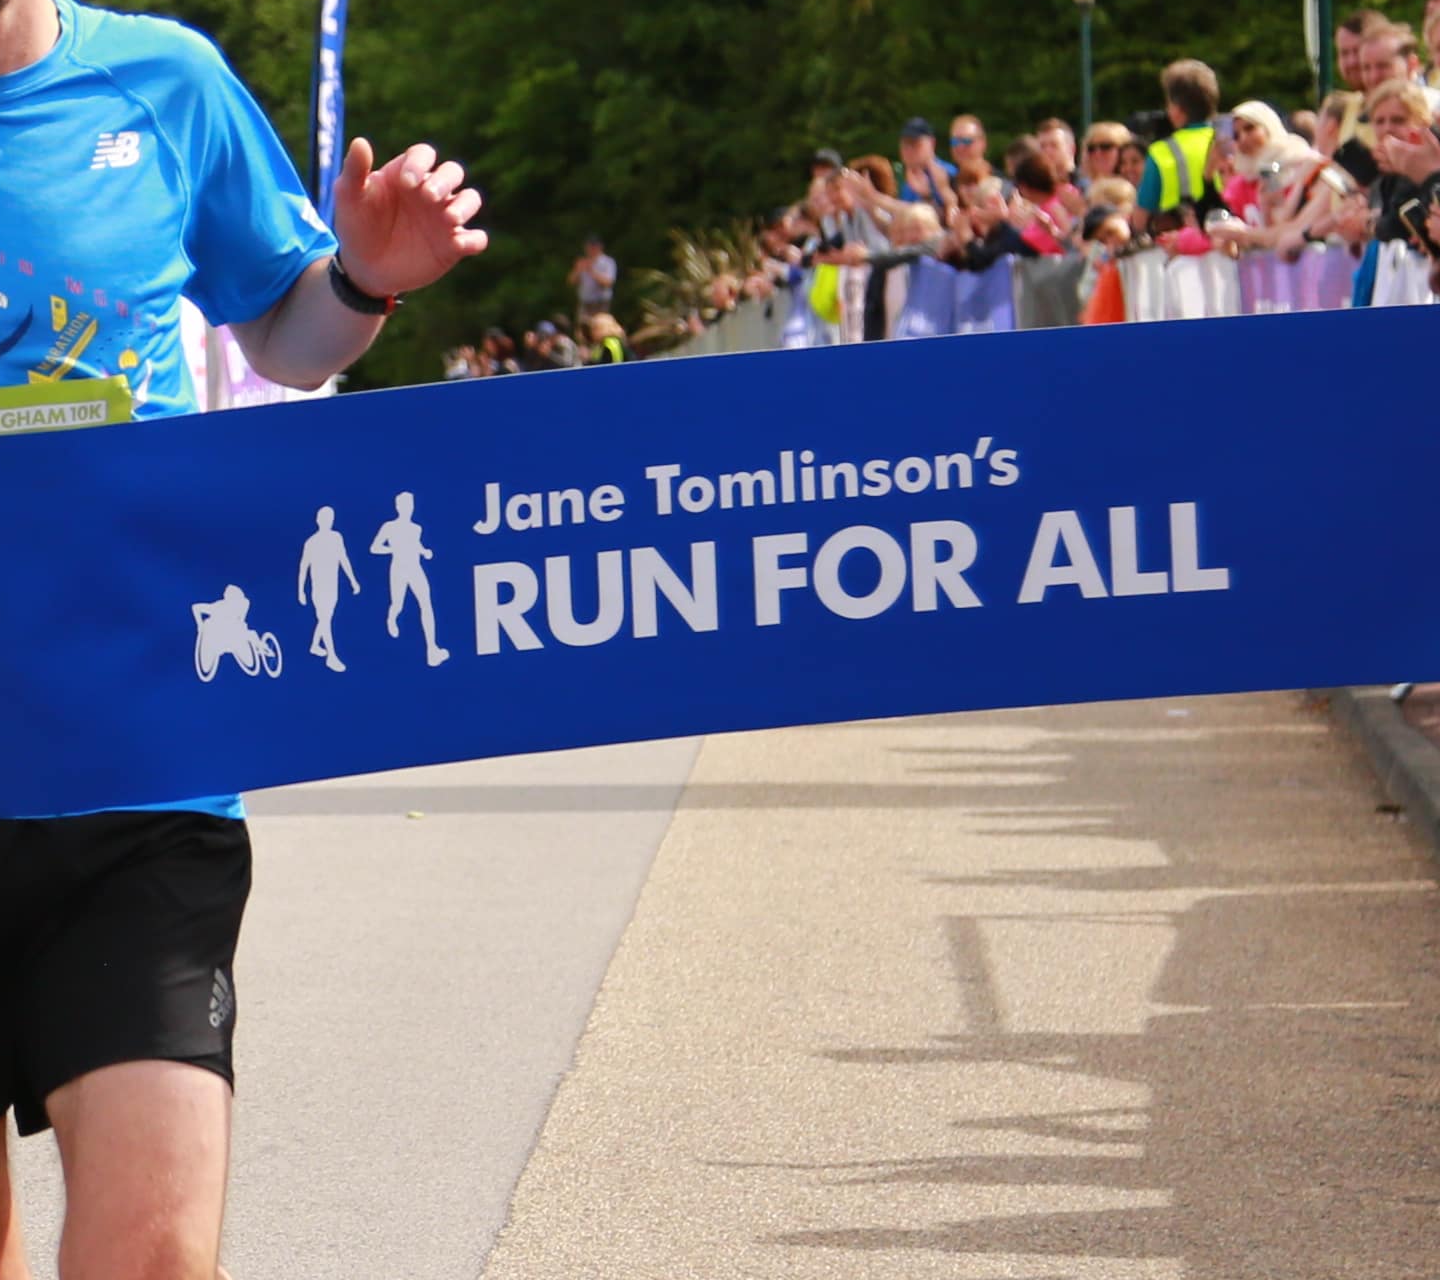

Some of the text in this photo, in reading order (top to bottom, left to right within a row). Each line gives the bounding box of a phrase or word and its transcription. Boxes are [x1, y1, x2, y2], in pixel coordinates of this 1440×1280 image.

[70, 404, 103, 421] 10K
[472, 436, 1020, 535] Jane Tomlinson's
[473, 501, 1230, 656] RUN FOR ALL
